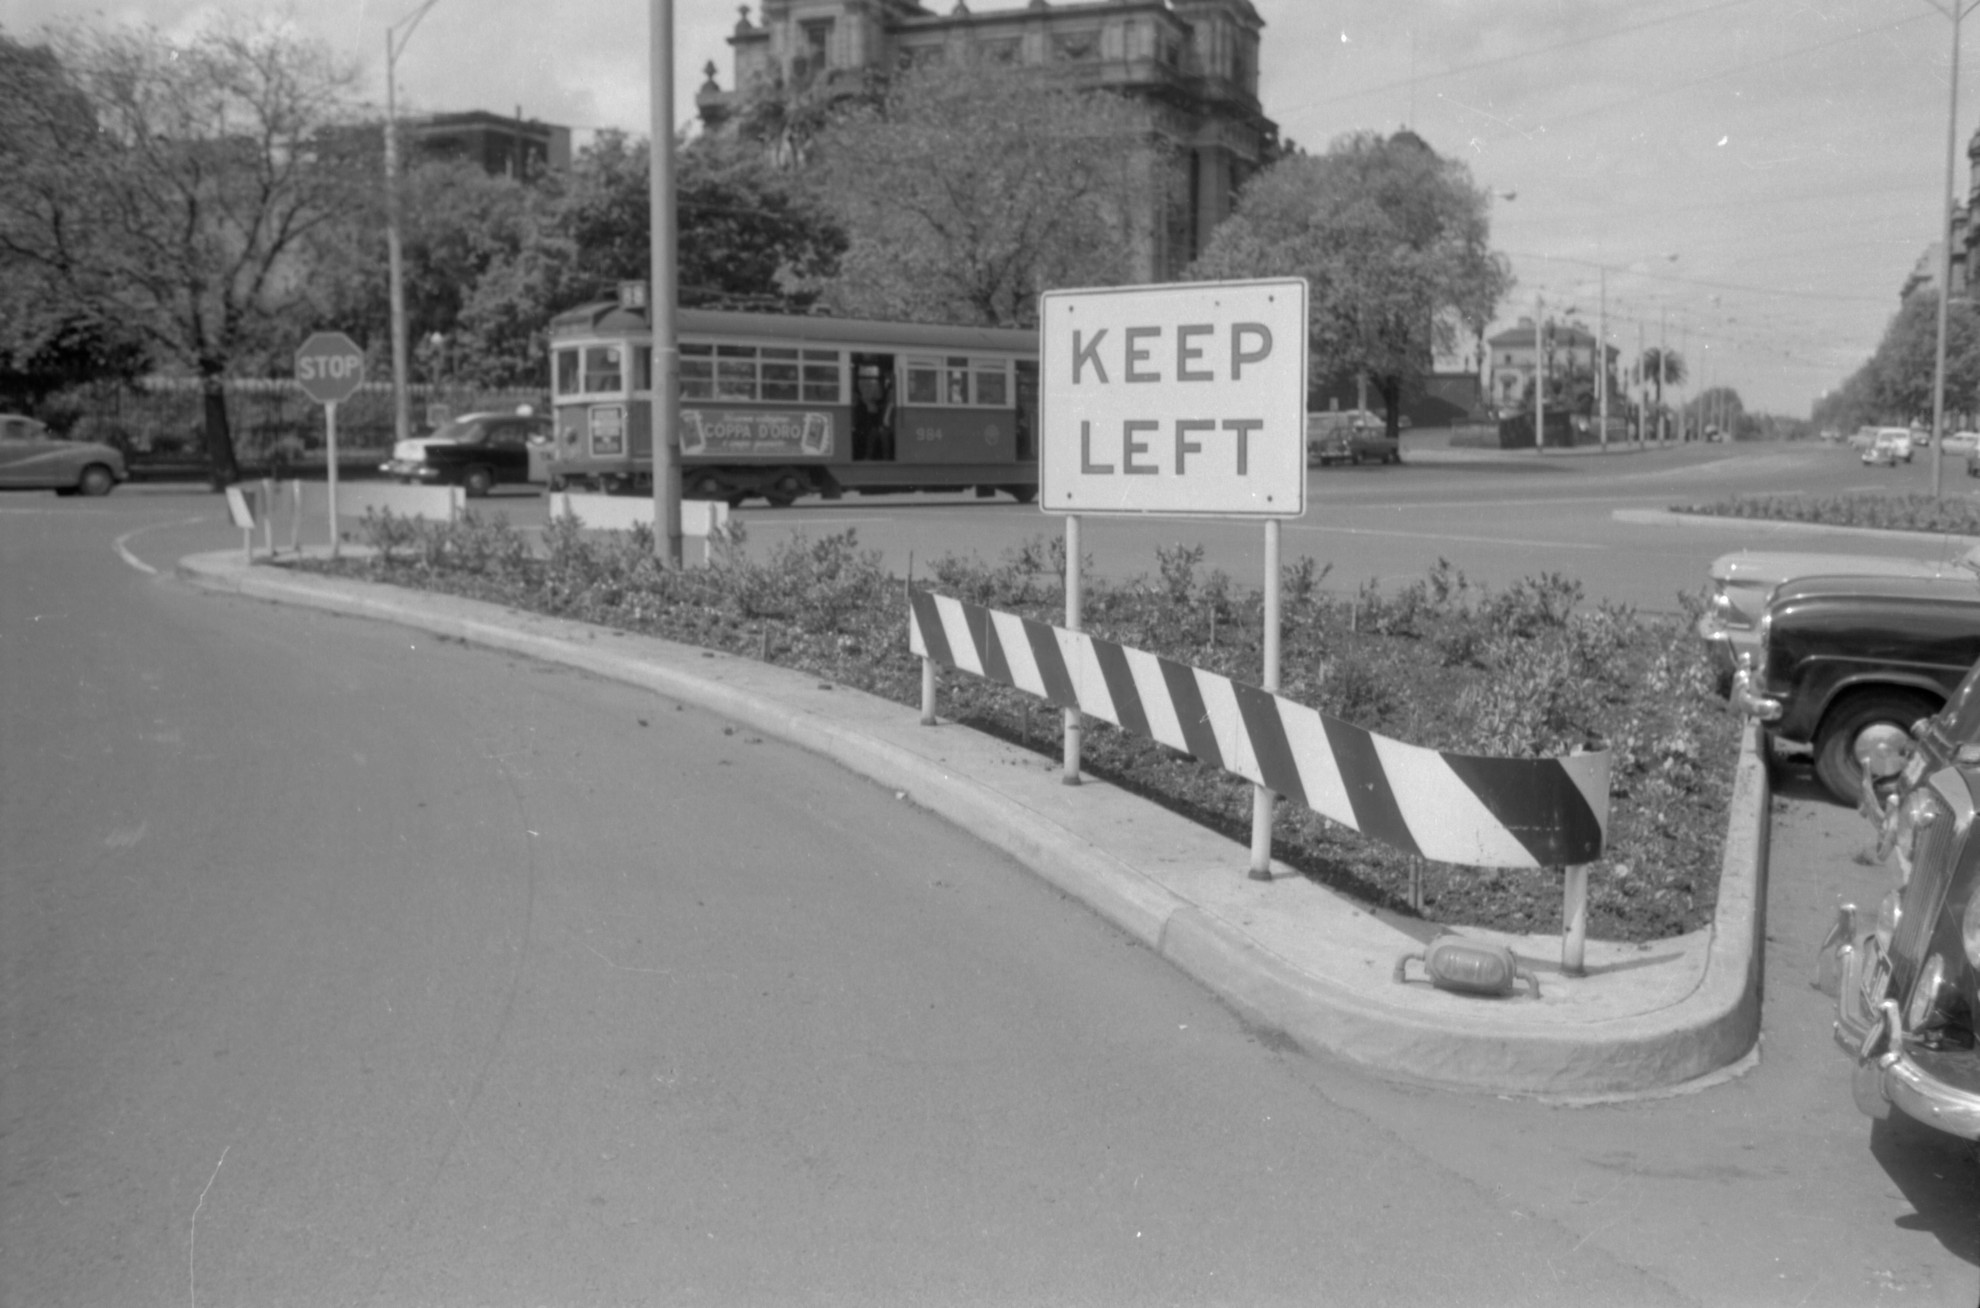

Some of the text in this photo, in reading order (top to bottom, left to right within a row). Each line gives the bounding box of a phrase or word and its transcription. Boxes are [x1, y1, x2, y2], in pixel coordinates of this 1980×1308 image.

[299, 355, 360, 380] STOP
[1072, 322, 1273, 385] KEEP
[704, 423, 801, 440] COPPA D'ORO
[1080, 418, 1264, 476] LEFT
